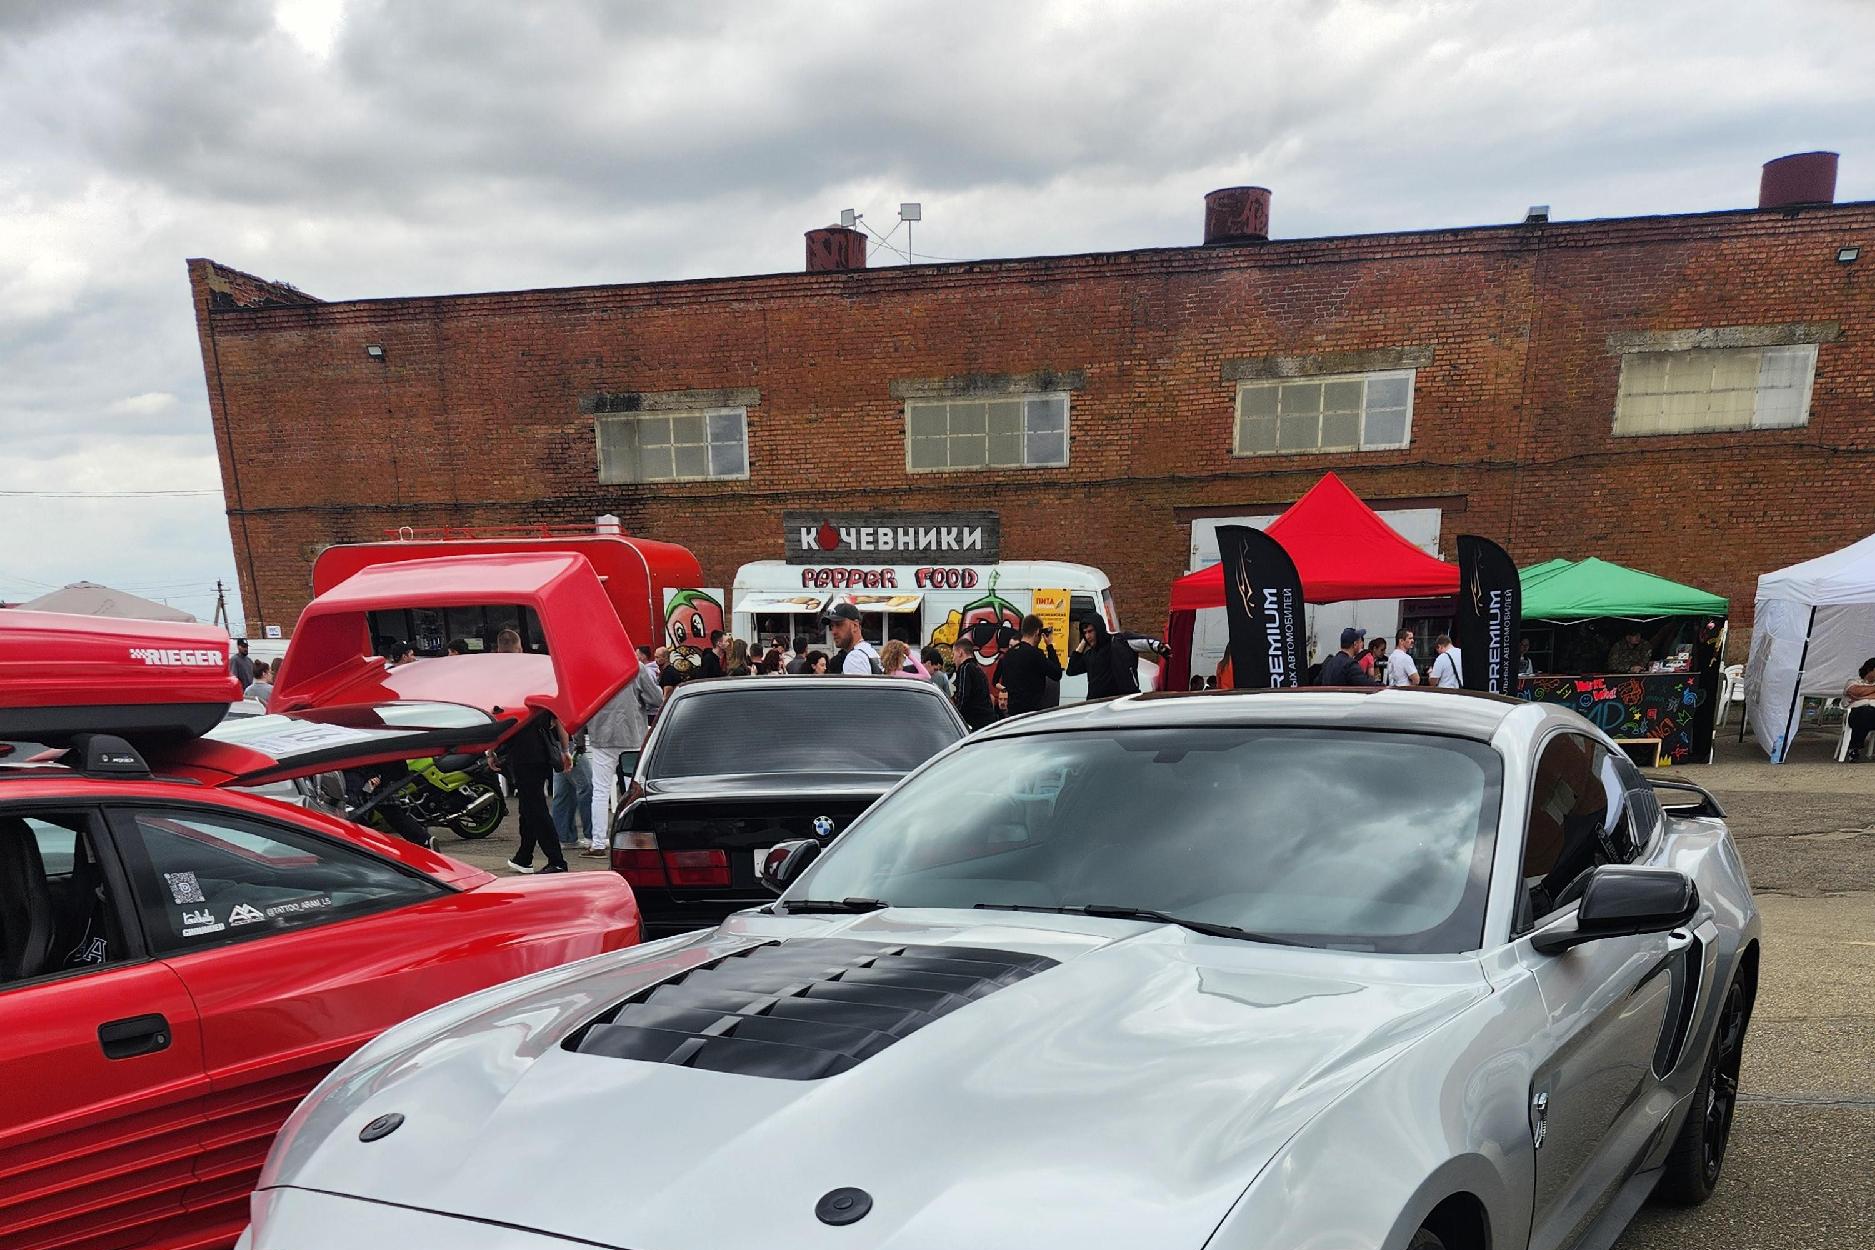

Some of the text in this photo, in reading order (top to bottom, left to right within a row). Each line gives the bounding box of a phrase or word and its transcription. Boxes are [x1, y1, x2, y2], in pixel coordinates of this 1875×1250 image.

[915, 567, 979, 589] FOOD
[144, 649, 224, 666] RIEGER
[1283, 588, 1296, 669] АВТОМОБИЛЕЙ
[1489, 590, 1502, 695] PREMIUM
[1502, 588, 1514, 659] АВТОМОБИЛЕЙ
